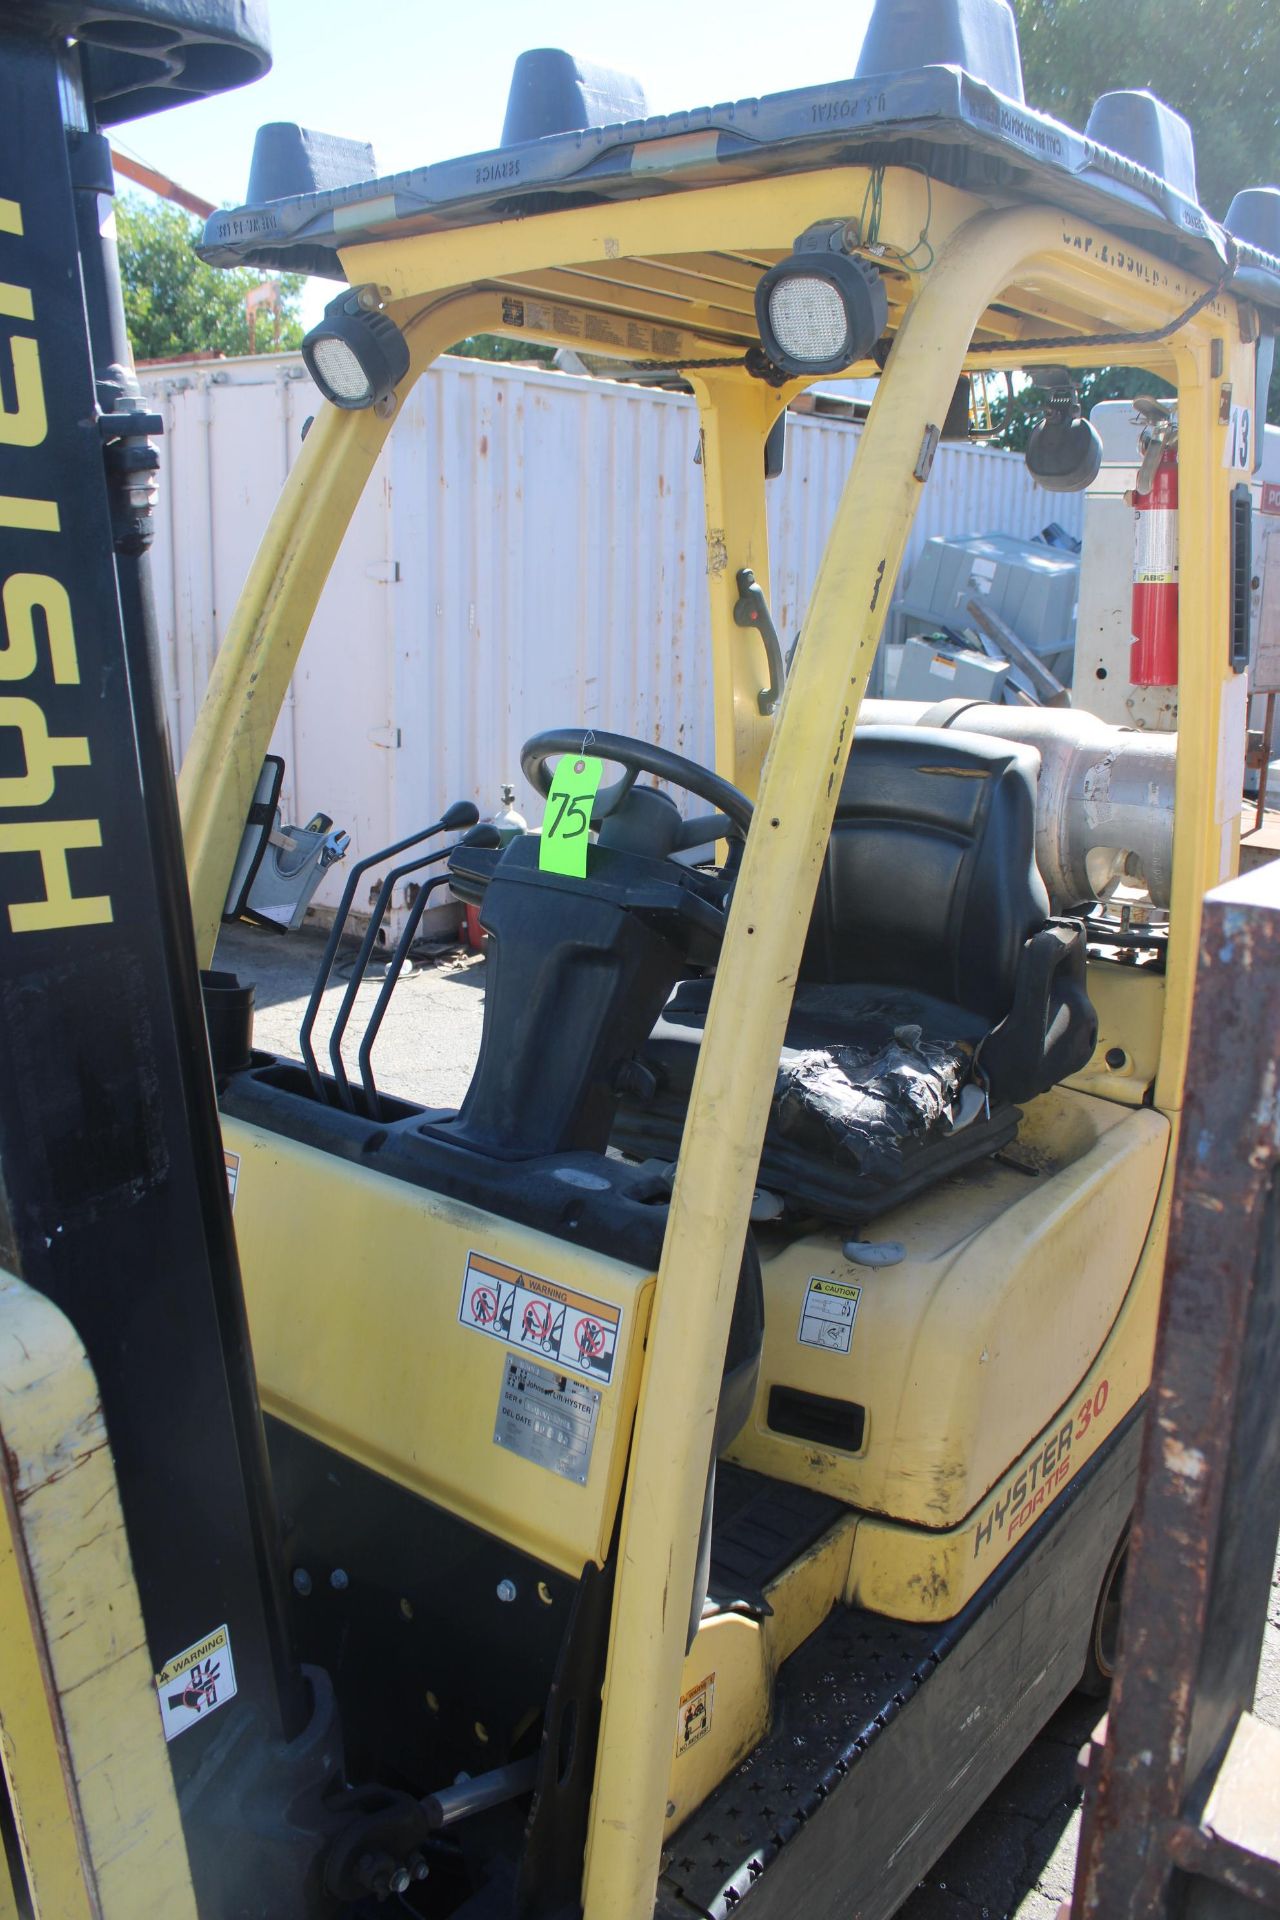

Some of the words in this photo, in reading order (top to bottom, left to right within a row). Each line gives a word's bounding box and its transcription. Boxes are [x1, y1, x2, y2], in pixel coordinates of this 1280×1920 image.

[811, 99, 859, 123] POSTAL
[475, 159, 520, 184] SERVICE
[1231, 407, 1250, 468] 13
[1142, 574, 1165, 582] ABC
[547, 792, 595, 838] 75
[528, 1279, 568, 1302] WARNING
[824, 1285, 856, 1297] CAUTION
[505, 1391, 518, 1403] SER
[502, 1407, 514, 1418] DEL
[515, 1412, 532, 1426] DATE
[974, 1419, 1073, 1559] HYSTER
[1075, 1379, 1109, 1441] 30
[1007, 1454, 1070, 1541] FORTIS
[173, 1635, 223, 1673] WARNING
